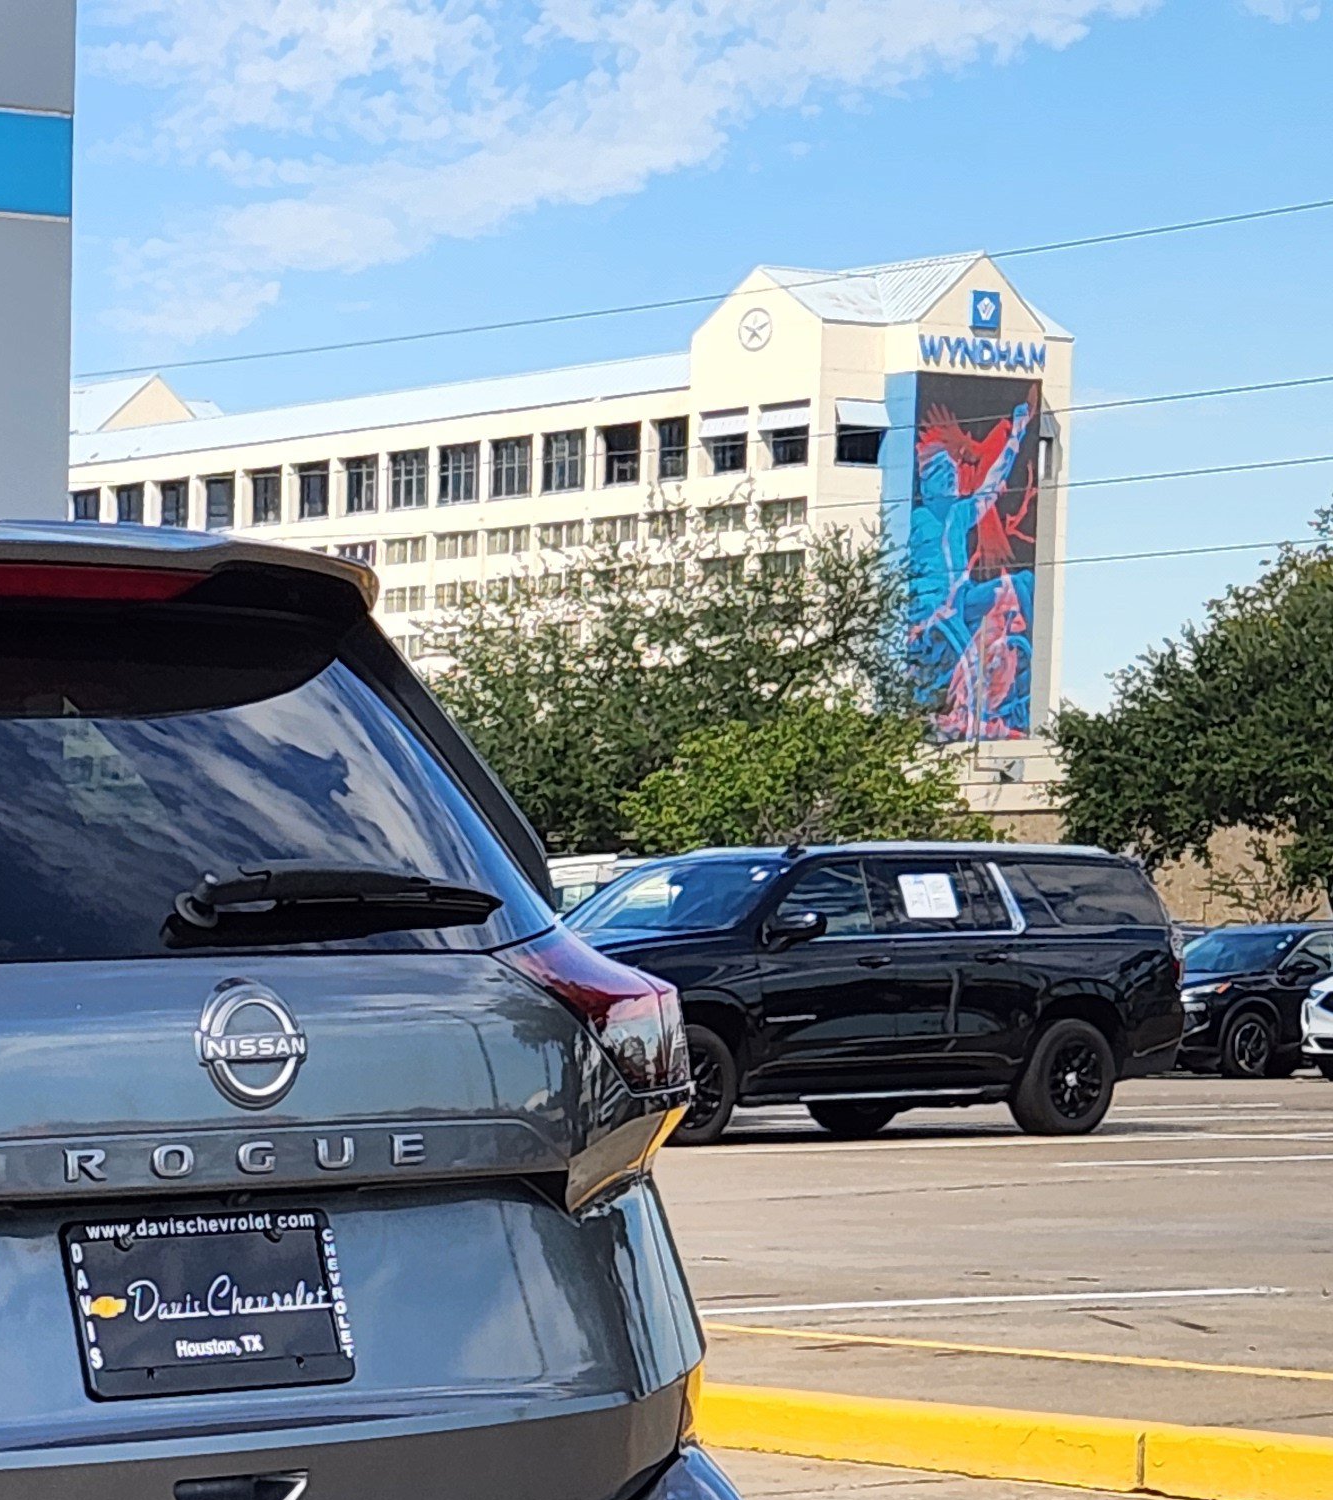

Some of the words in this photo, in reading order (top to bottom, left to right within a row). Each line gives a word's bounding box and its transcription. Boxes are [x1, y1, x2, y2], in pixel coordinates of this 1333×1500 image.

[918, 333, 1046, 372] WYNDHAM
[205, 1035, 306, 1059] NISSAN
[63, 1133, 426, 1182] ROGUE
[85, 1212, 315, 1240] www.davischevroletcom
[70, 1242, 103, 1369] DAVIS
[127, 1279, 209, 1322] Davis
[207, 1274, 333, 1316] Chevrolet
[321, 1228, 354, 1358] CHEVROLET
[240, 1334, 264, 1353] TX
